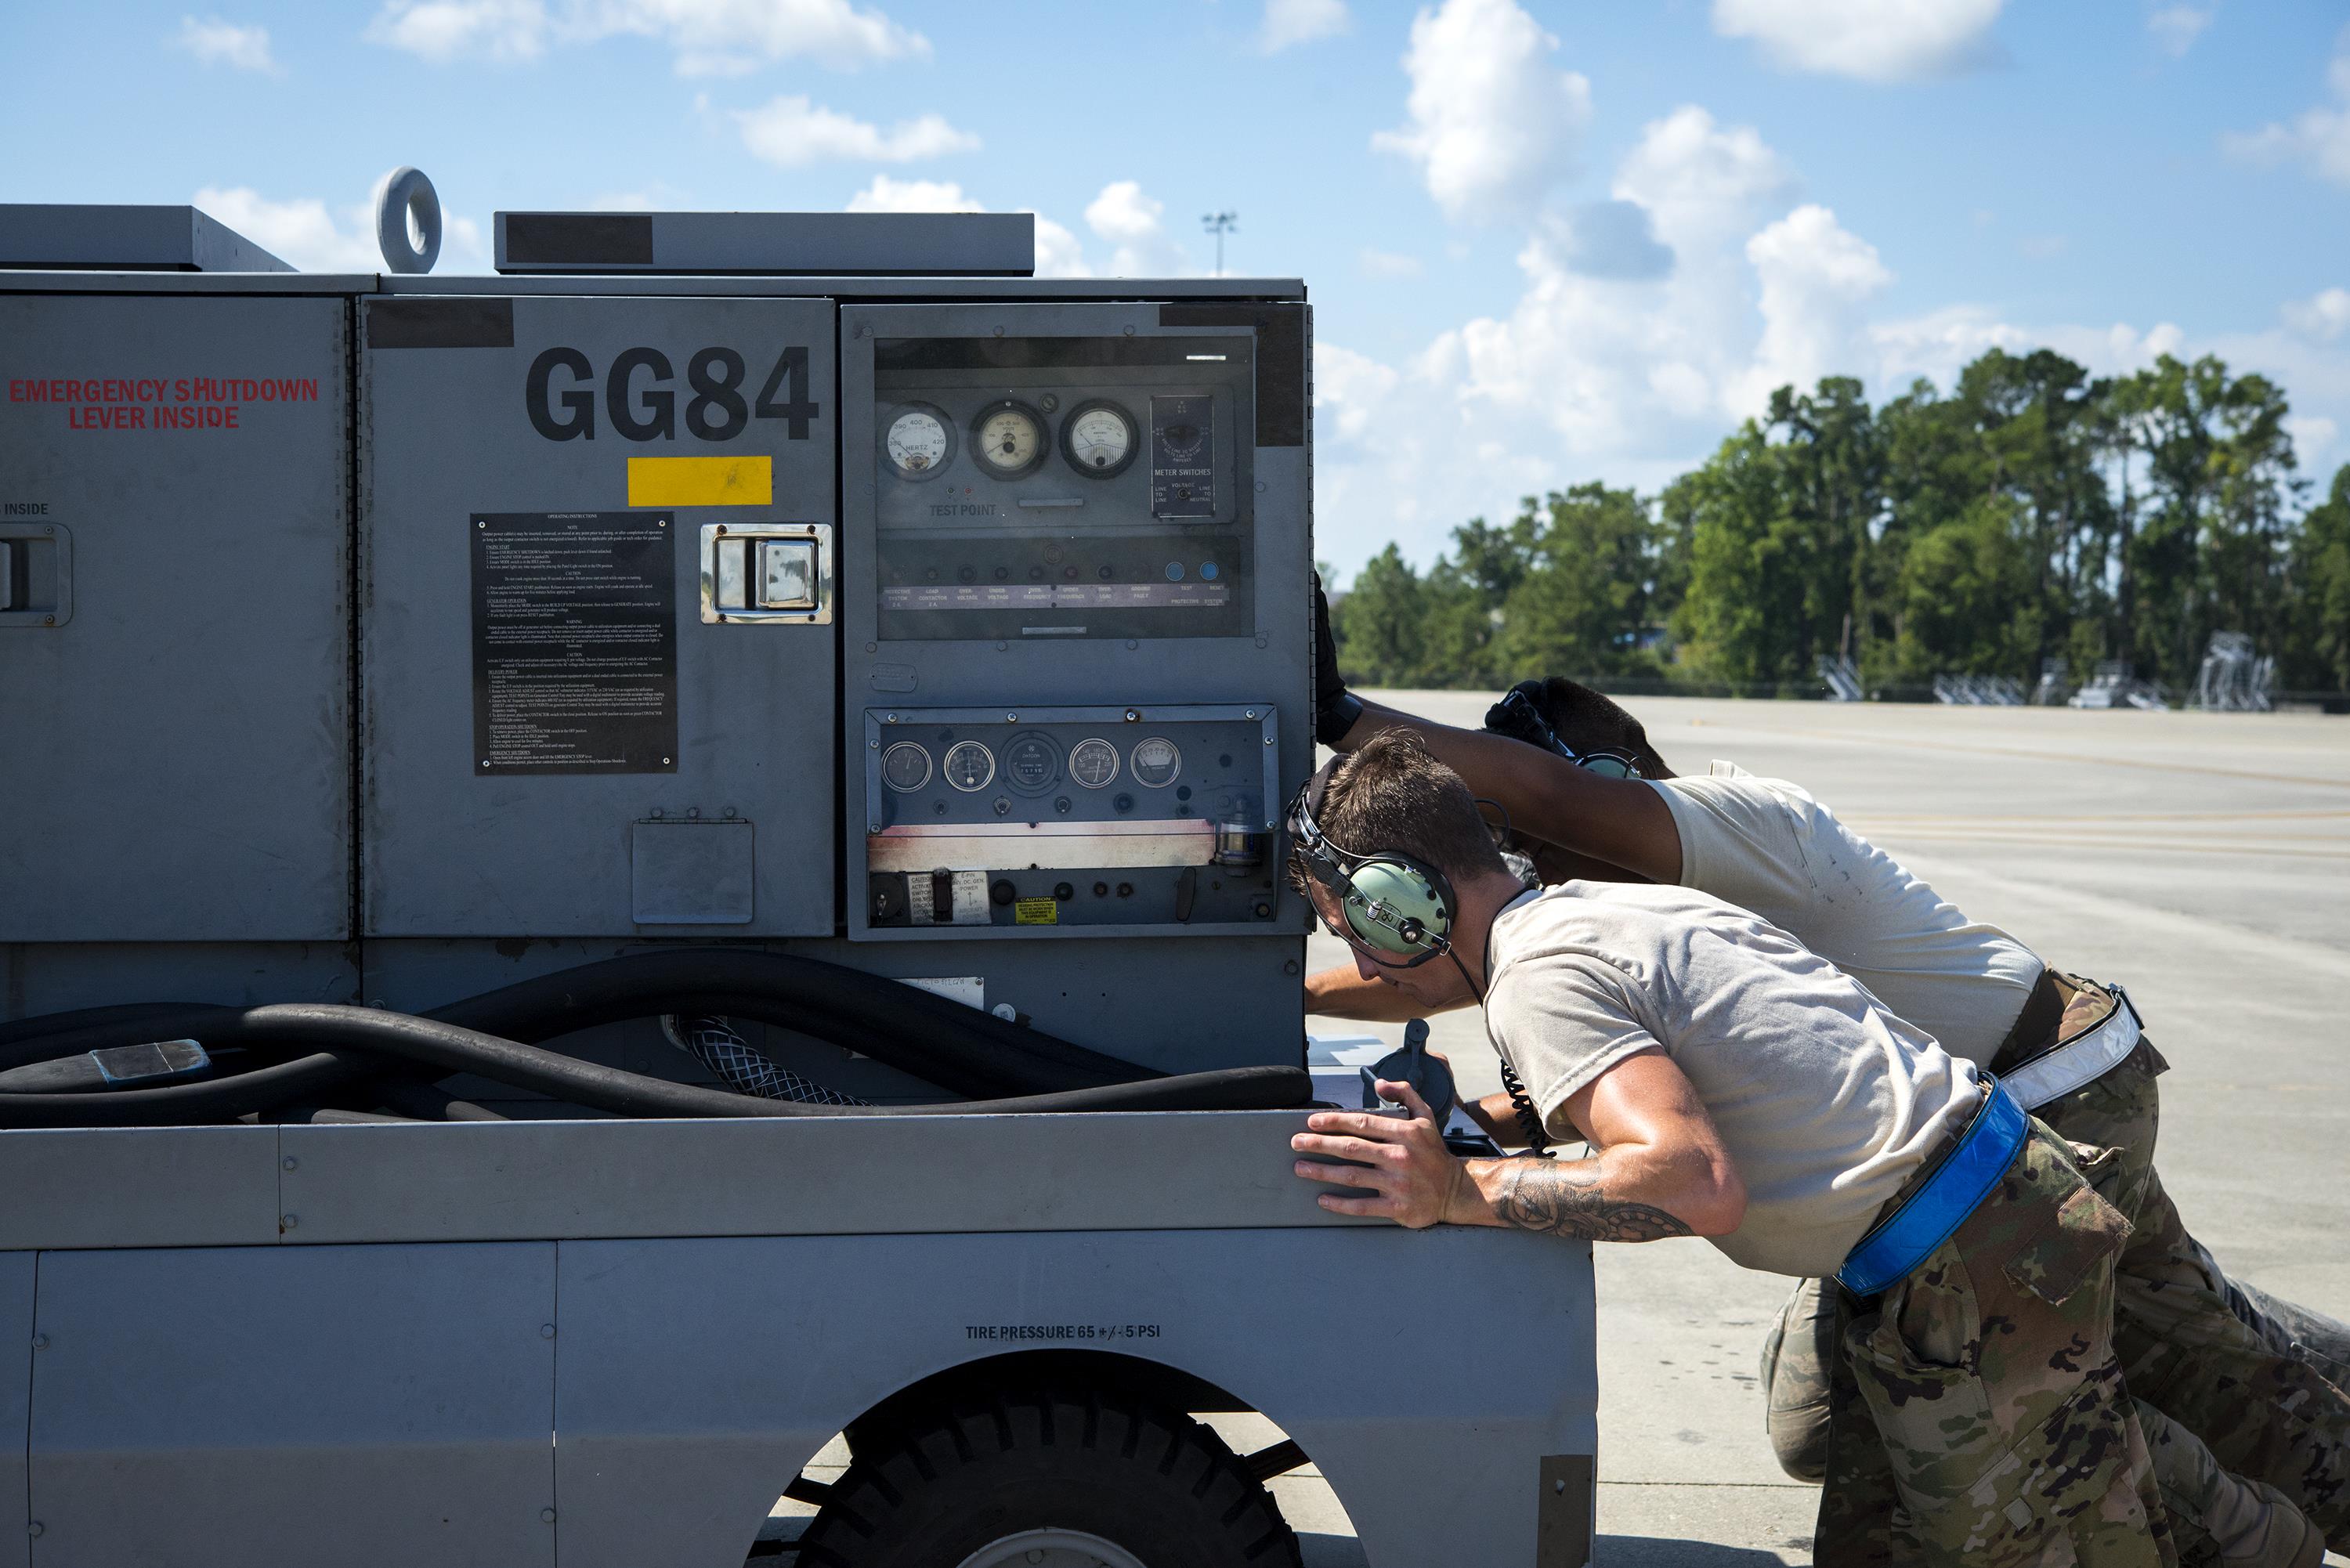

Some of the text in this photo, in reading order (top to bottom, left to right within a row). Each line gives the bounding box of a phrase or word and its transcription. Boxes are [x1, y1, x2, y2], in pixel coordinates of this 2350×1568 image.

[9, 377, 319, 403] EMERGENCY SHUTDOWN
[526, 345, 820, 442] GG84
[69, 405, 240, 429] LEVER INSIDE
[5, 504, 48, 515] INSIDE
[929, 503, 996, 517] TEST POINT
[966, 1326, 996, 1339] TIRE
[1000, 1326, 1074, 1339] PRESSURE
[1077, 1326, 1095, 1338] 65
[1126, 1325, 1134, 1337] 5
[1138, 1325, 1160, 1337] PSI
